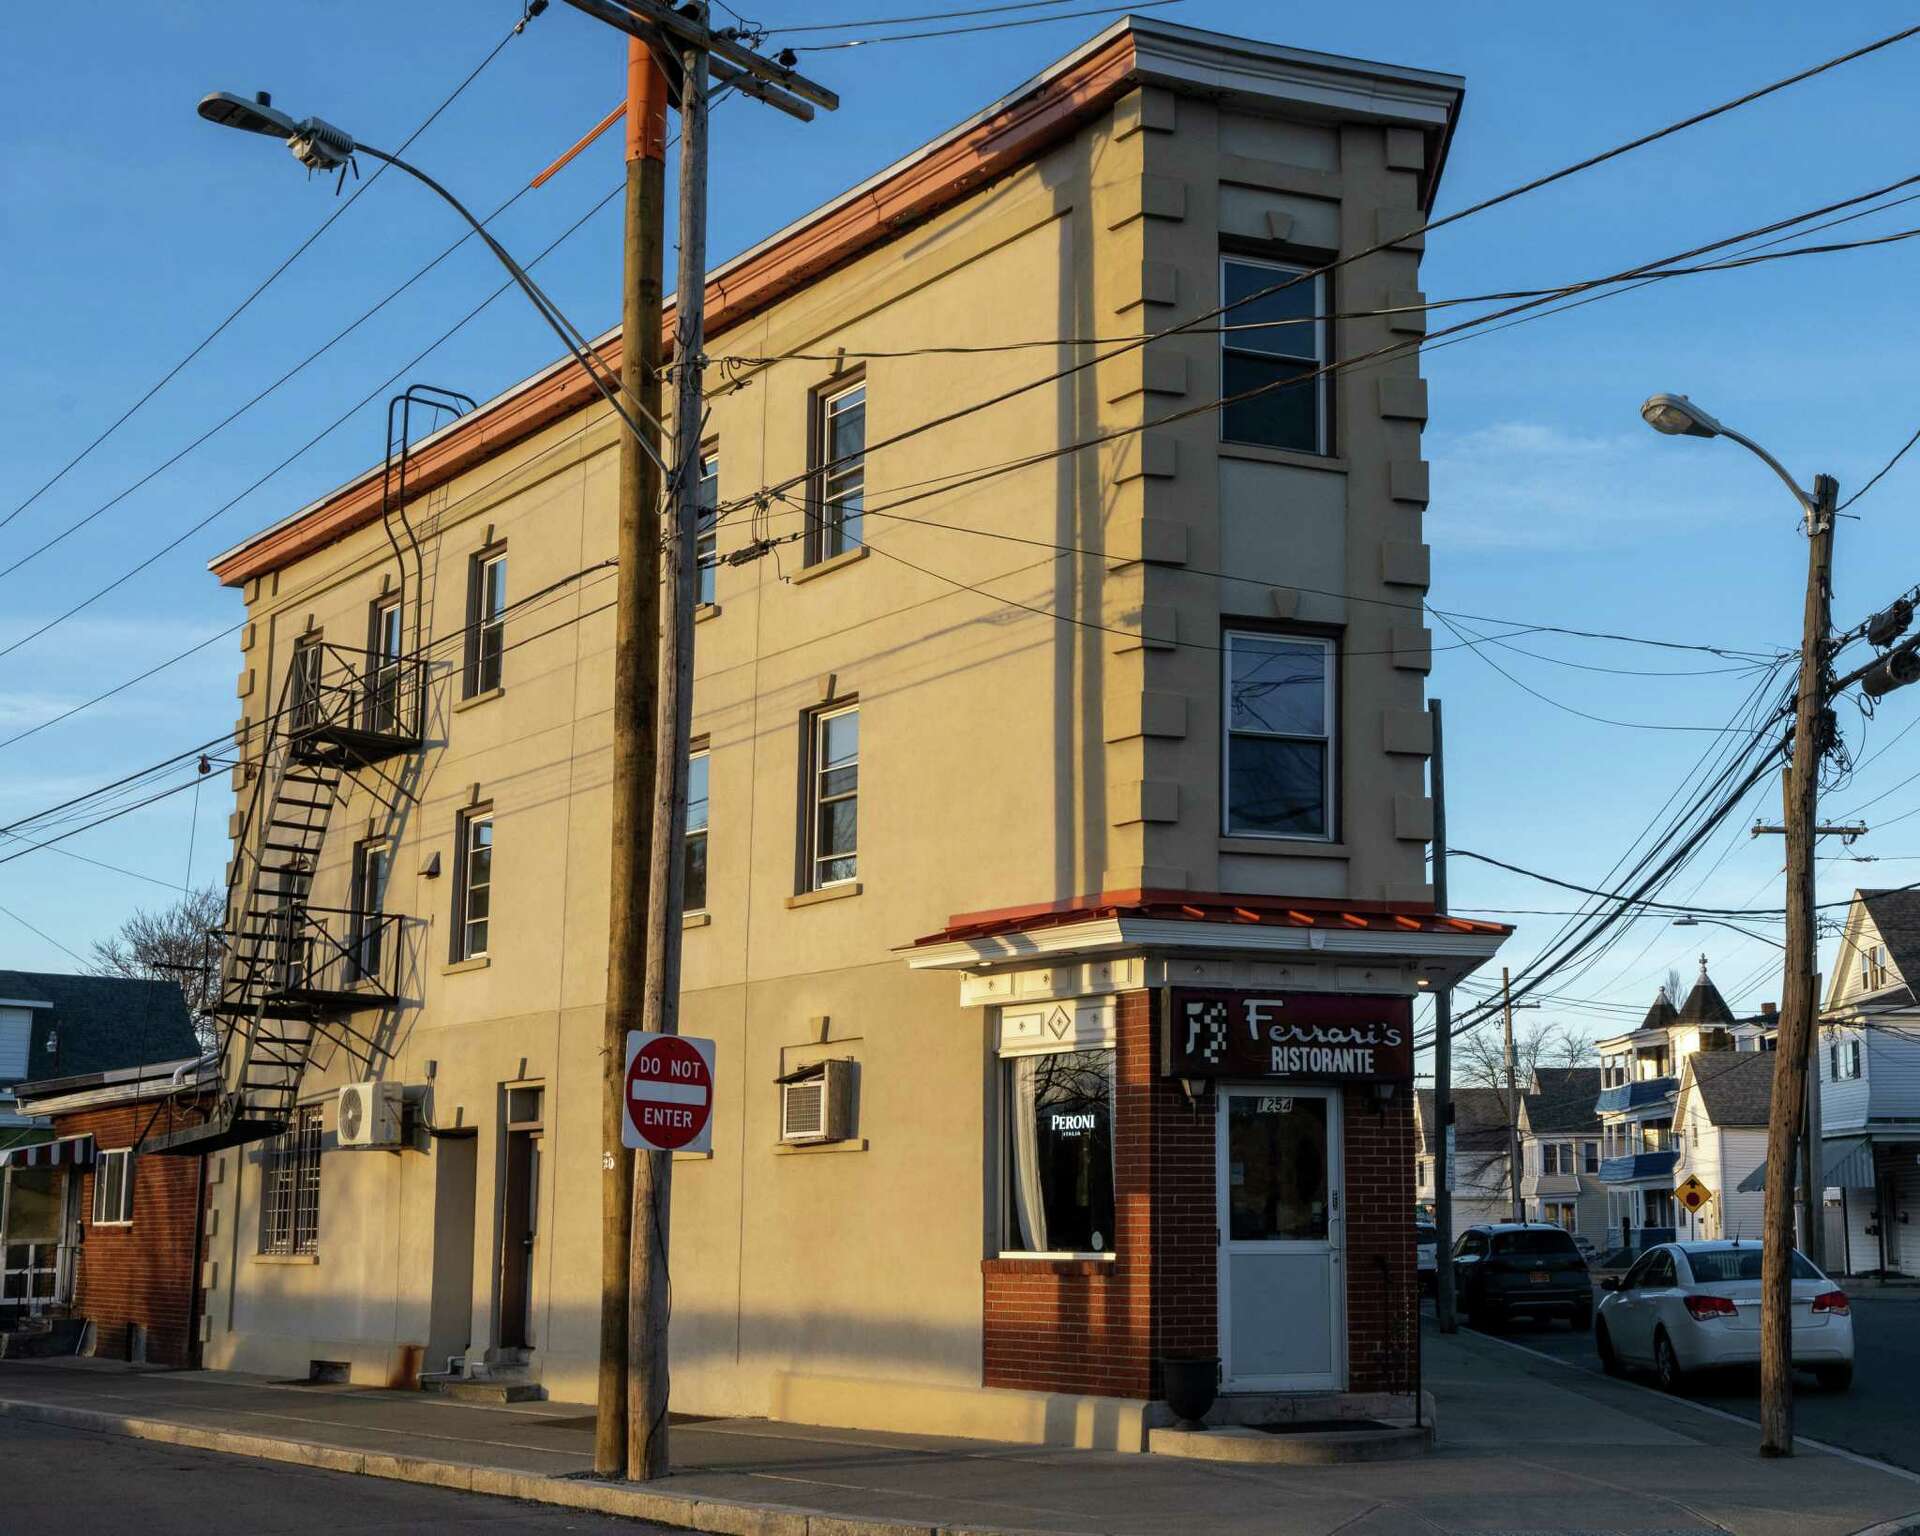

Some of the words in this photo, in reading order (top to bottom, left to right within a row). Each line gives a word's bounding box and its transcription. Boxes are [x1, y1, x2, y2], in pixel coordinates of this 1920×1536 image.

[1243, 999, 1402, 1047] Ferrari's
[640, 1056, 661, 1075] DO
[671, 1060, 701, 1079] NOT
[1271, 1046, 1375, 1074] RISTORANTE
[644, 1107, 692, 1128] ENTER
[1051, 1114, 1095, 1130] PERONI
